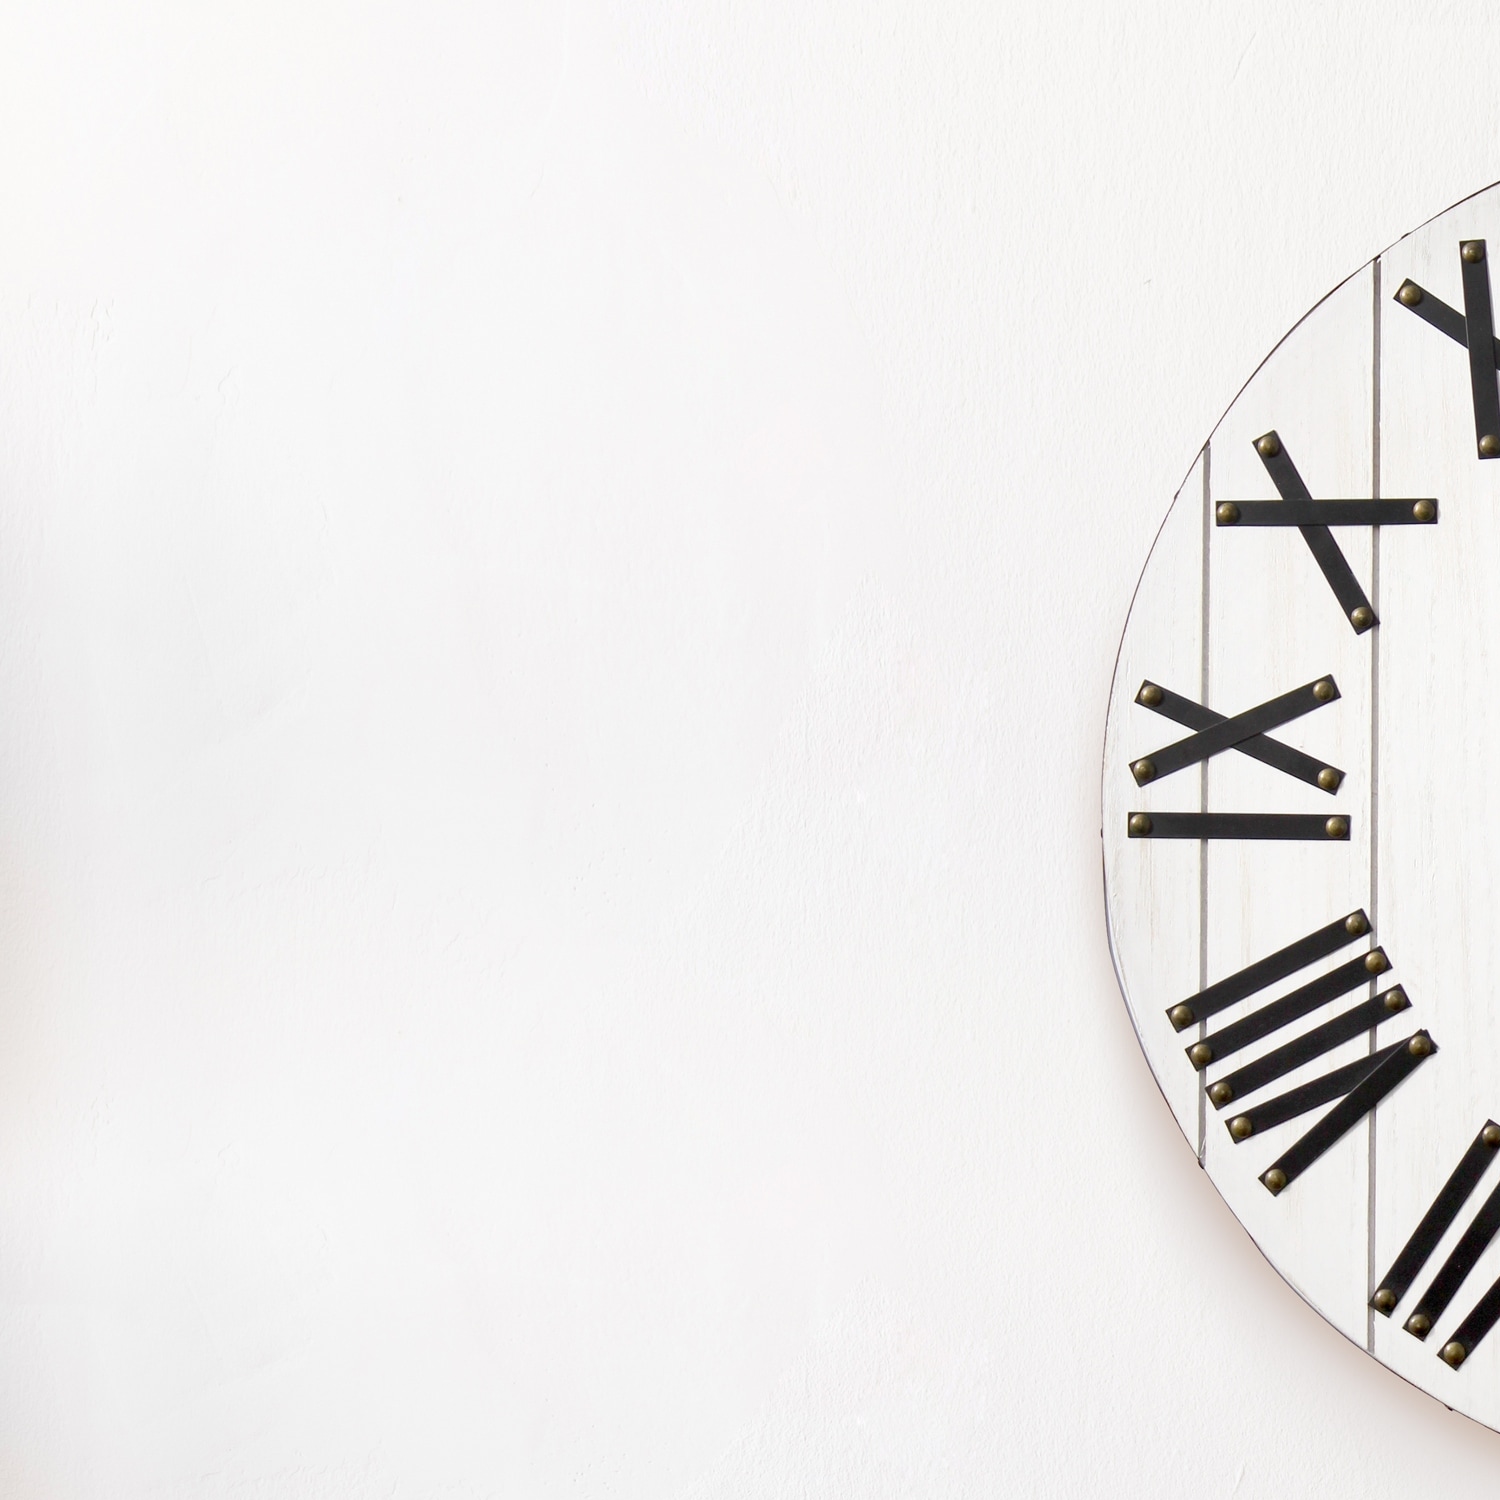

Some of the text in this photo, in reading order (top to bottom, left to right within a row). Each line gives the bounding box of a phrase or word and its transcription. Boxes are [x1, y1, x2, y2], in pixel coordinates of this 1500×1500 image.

[1216, 430, 1438, 635] X
[1128, 674, 1350, 842] IX
[1166, 908, 1438, 1196] VIII
